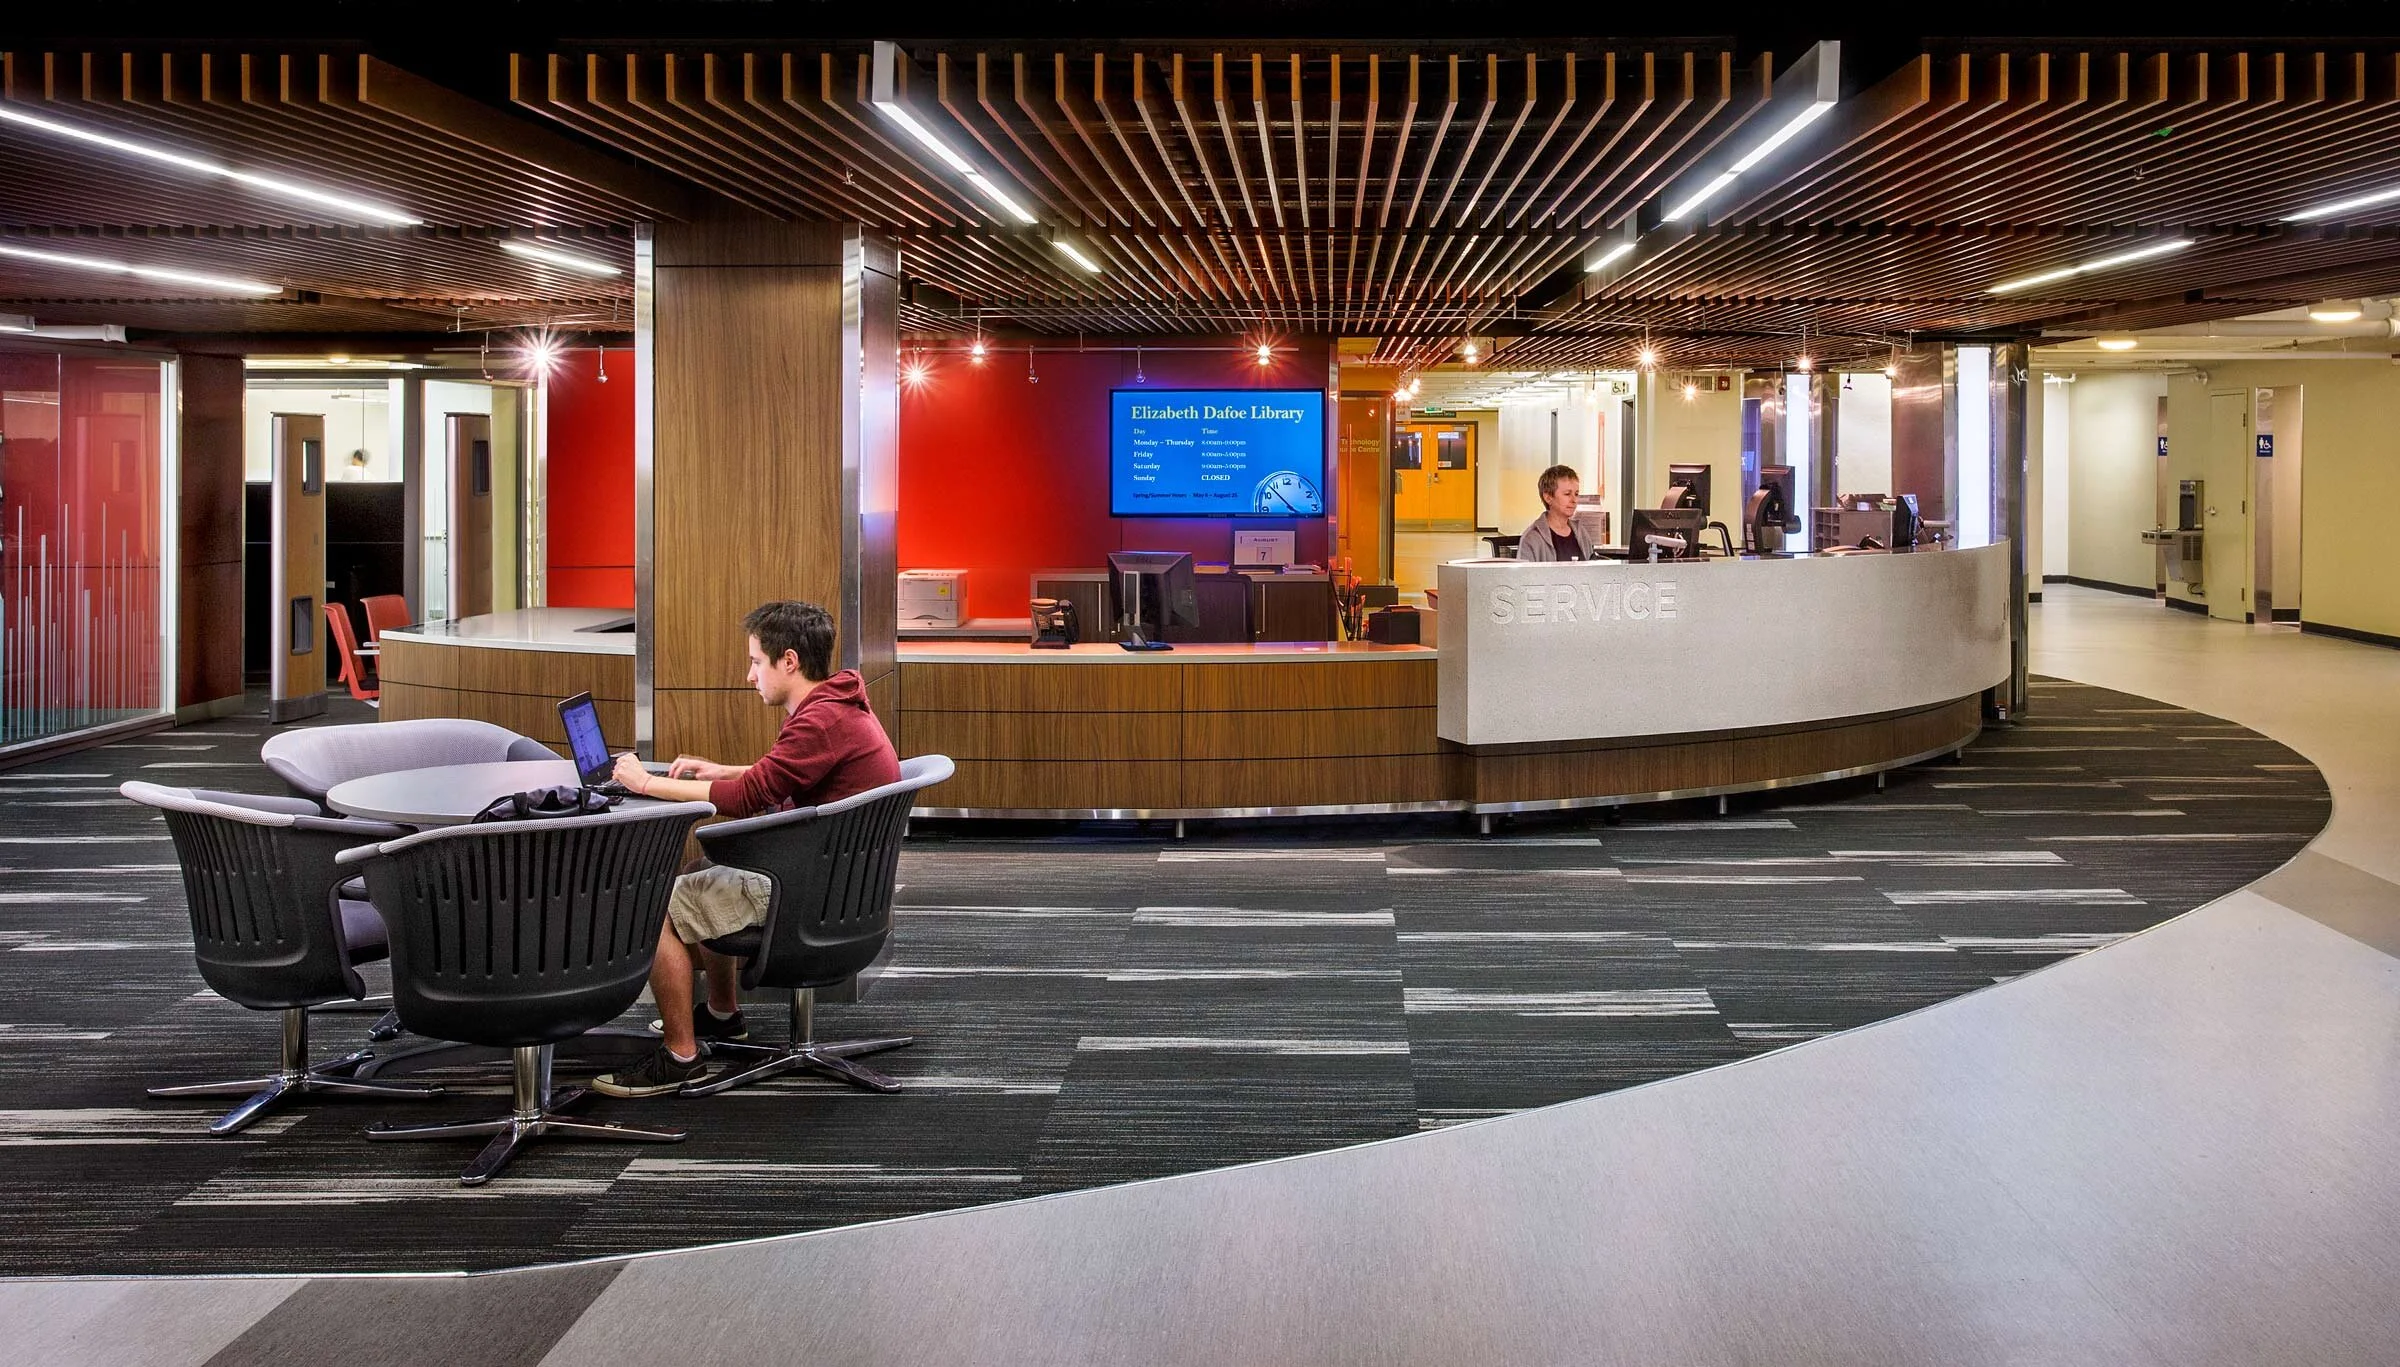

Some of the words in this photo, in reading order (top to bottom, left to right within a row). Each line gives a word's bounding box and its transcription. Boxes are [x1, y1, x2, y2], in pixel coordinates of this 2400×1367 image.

[1132, 405, 1198, 419] Elizabeth
[1204, 405, 1247, 419] Dafoe
[1251, 405, 1304, 424] Library
[1133, 428, 1146, 436] Day
[1133, 451, 1153, 459] Friday
[1133, 463, 1161, 471] Saturday
[1260, 551, 1267, 561] 7
[1489, 581, 1678, 625] SERVICE
